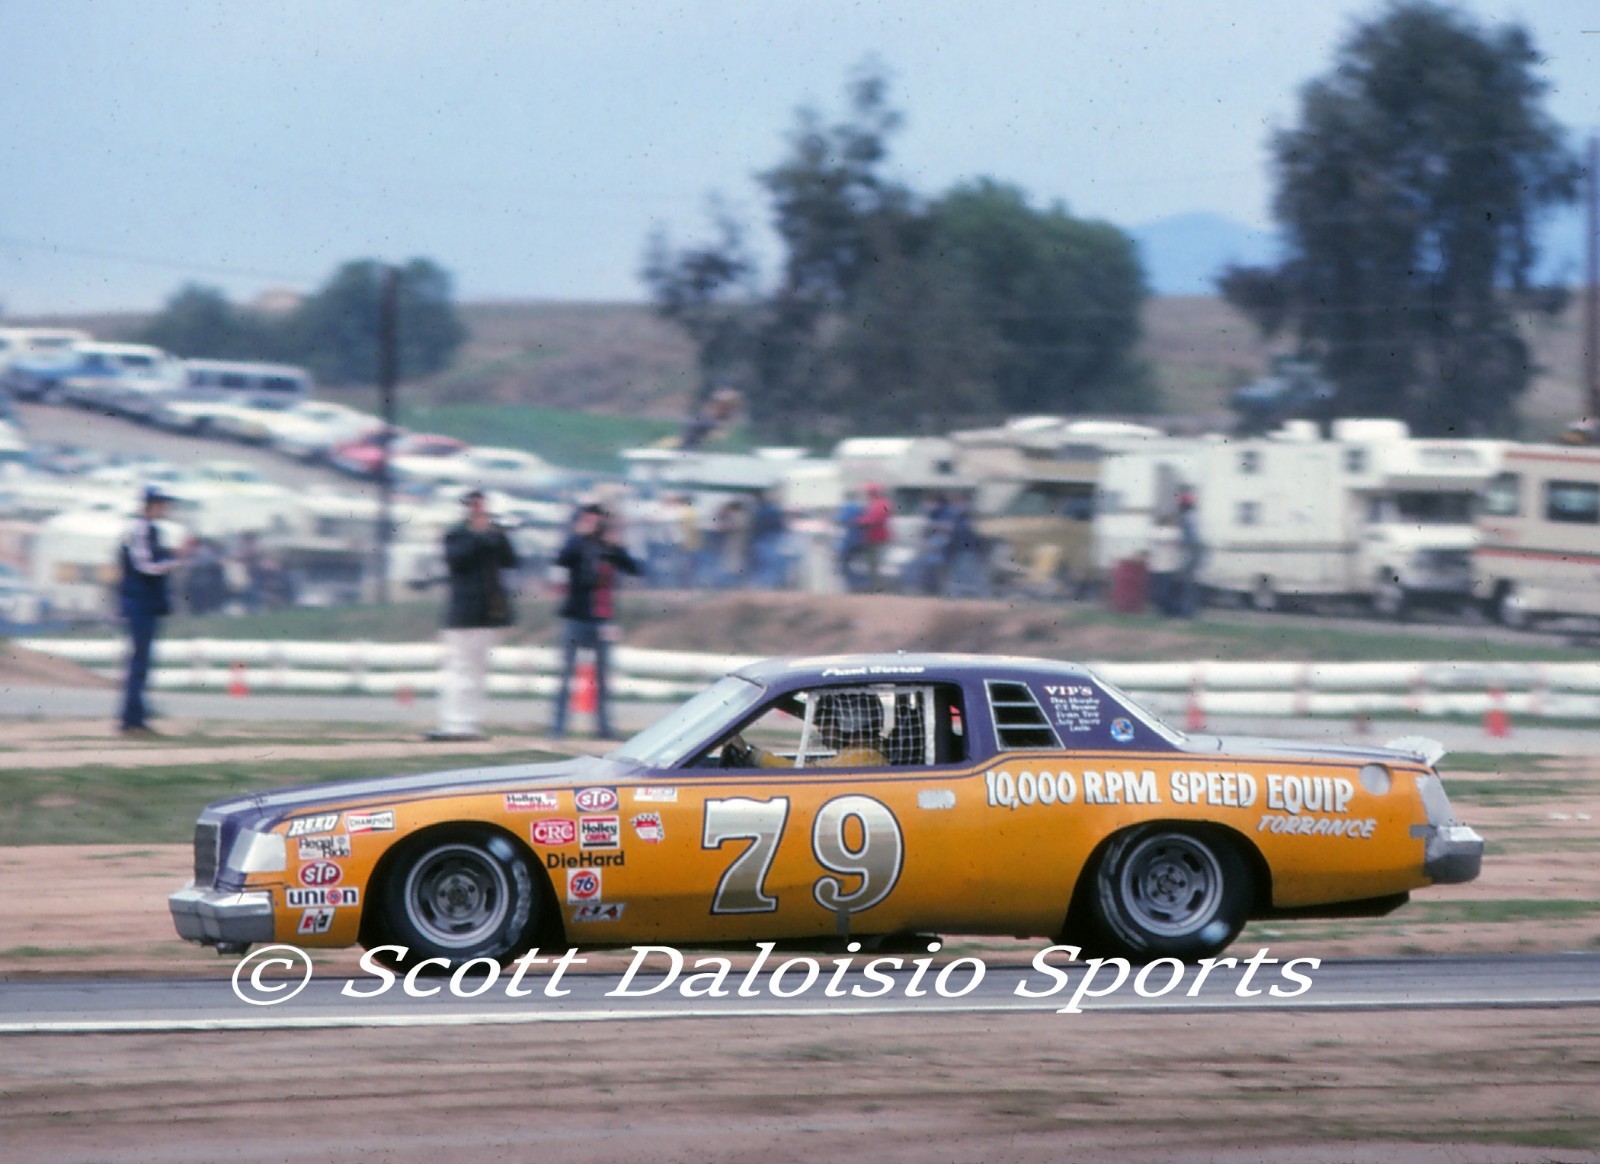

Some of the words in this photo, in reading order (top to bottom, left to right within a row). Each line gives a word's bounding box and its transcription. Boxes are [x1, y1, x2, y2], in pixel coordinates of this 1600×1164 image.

[581, 789, 612, 807] STP
[985, 770, 1076, 809] 10,000
[1170, 772, 1258, 807] SPEED
[507, 794, 542, 804] Holley
[349, 816, 392, 828] CHAMPION
[582, 823, 618, 836] Holley
[1257, 814, 1379, 839] TORRANCE
[534, 825, 574, 842] CRC
[300, 836, 335, 851] Regal
[322, 847, 350, 858] Ride
[546, 851, 625, 869] DieHard
[701, 794, 905, 915] 79
[304, 862, 338, 884] STP
[575, 876, 595, 892] 76
